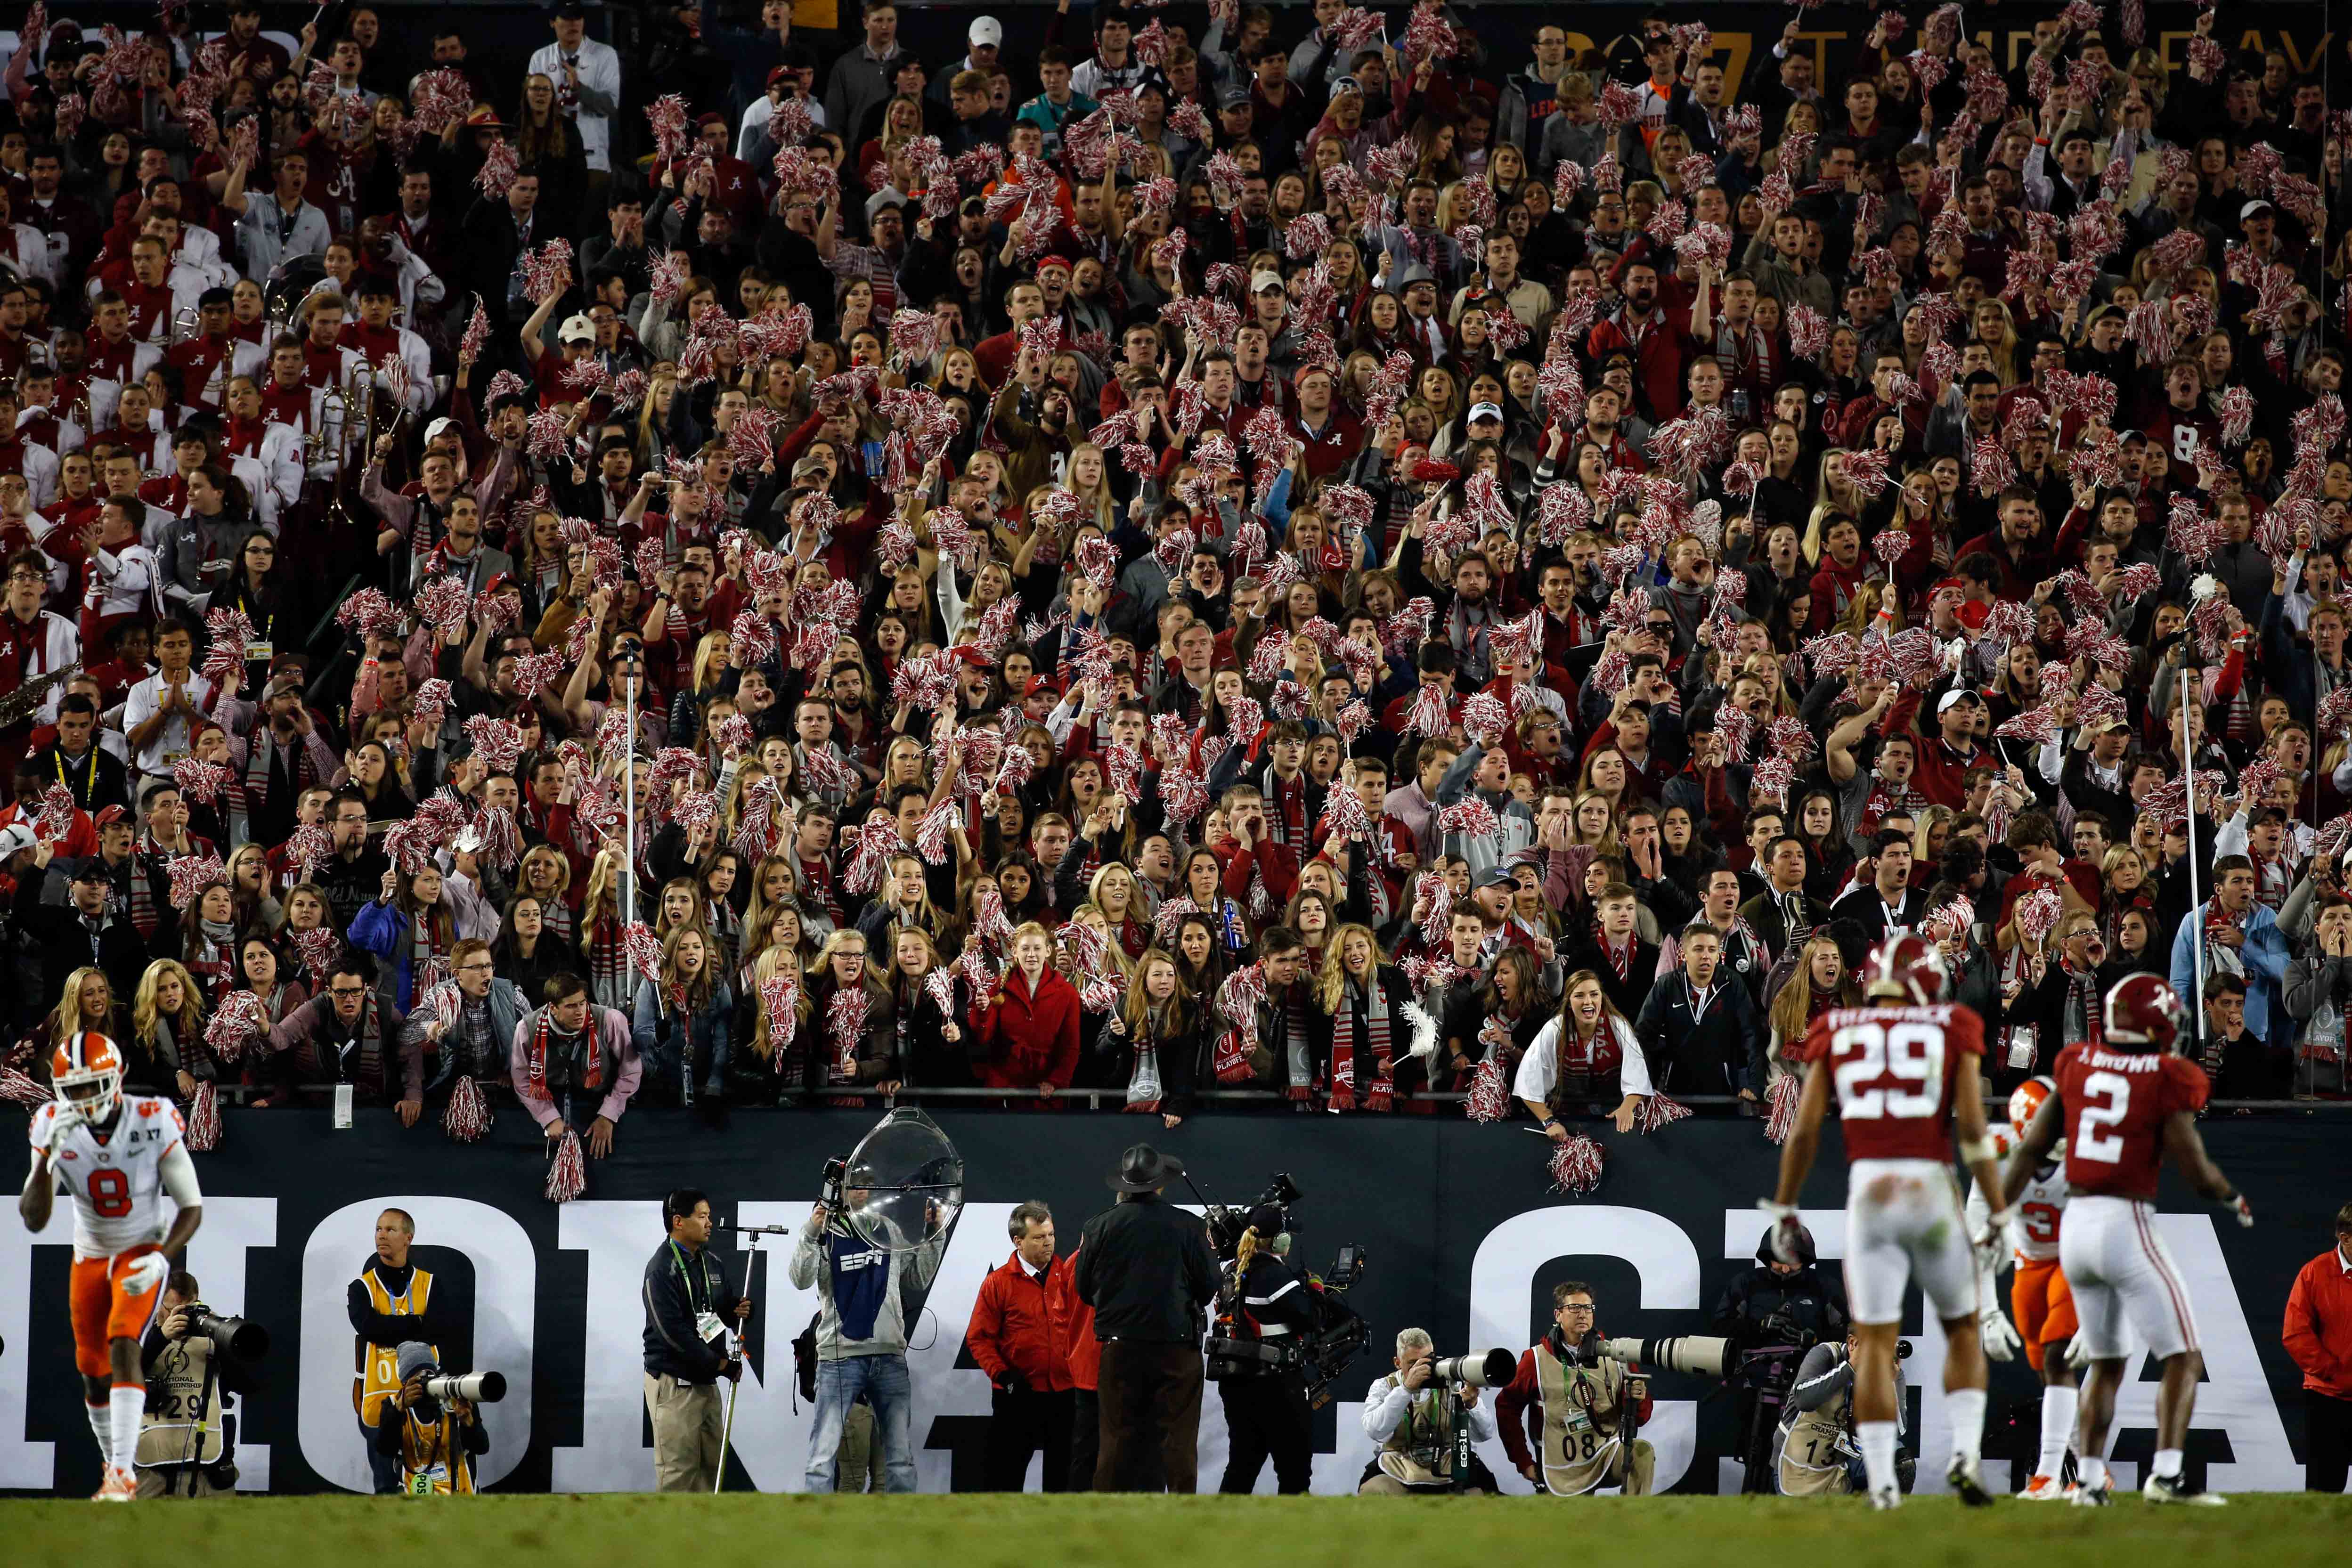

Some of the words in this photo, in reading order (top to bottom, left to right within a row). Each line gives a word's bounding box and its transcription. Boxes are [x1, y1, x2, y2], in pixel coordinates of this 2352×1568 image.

[1327, 433, 1342, 446] A
[160, 494, 174, 507] A
[0, 641, 12, 657] A
[116, 678, 130, 689] A
[1034, 674, 1048, 686] A
[1856, 969, 1864, 983] A
[1831, 1022, 1945, 1121] 29
[2075, 1072, 2132, 1164] 2
[88, 1169, 133, 1218] 8
[155, 1395, 200, 1421] 29
